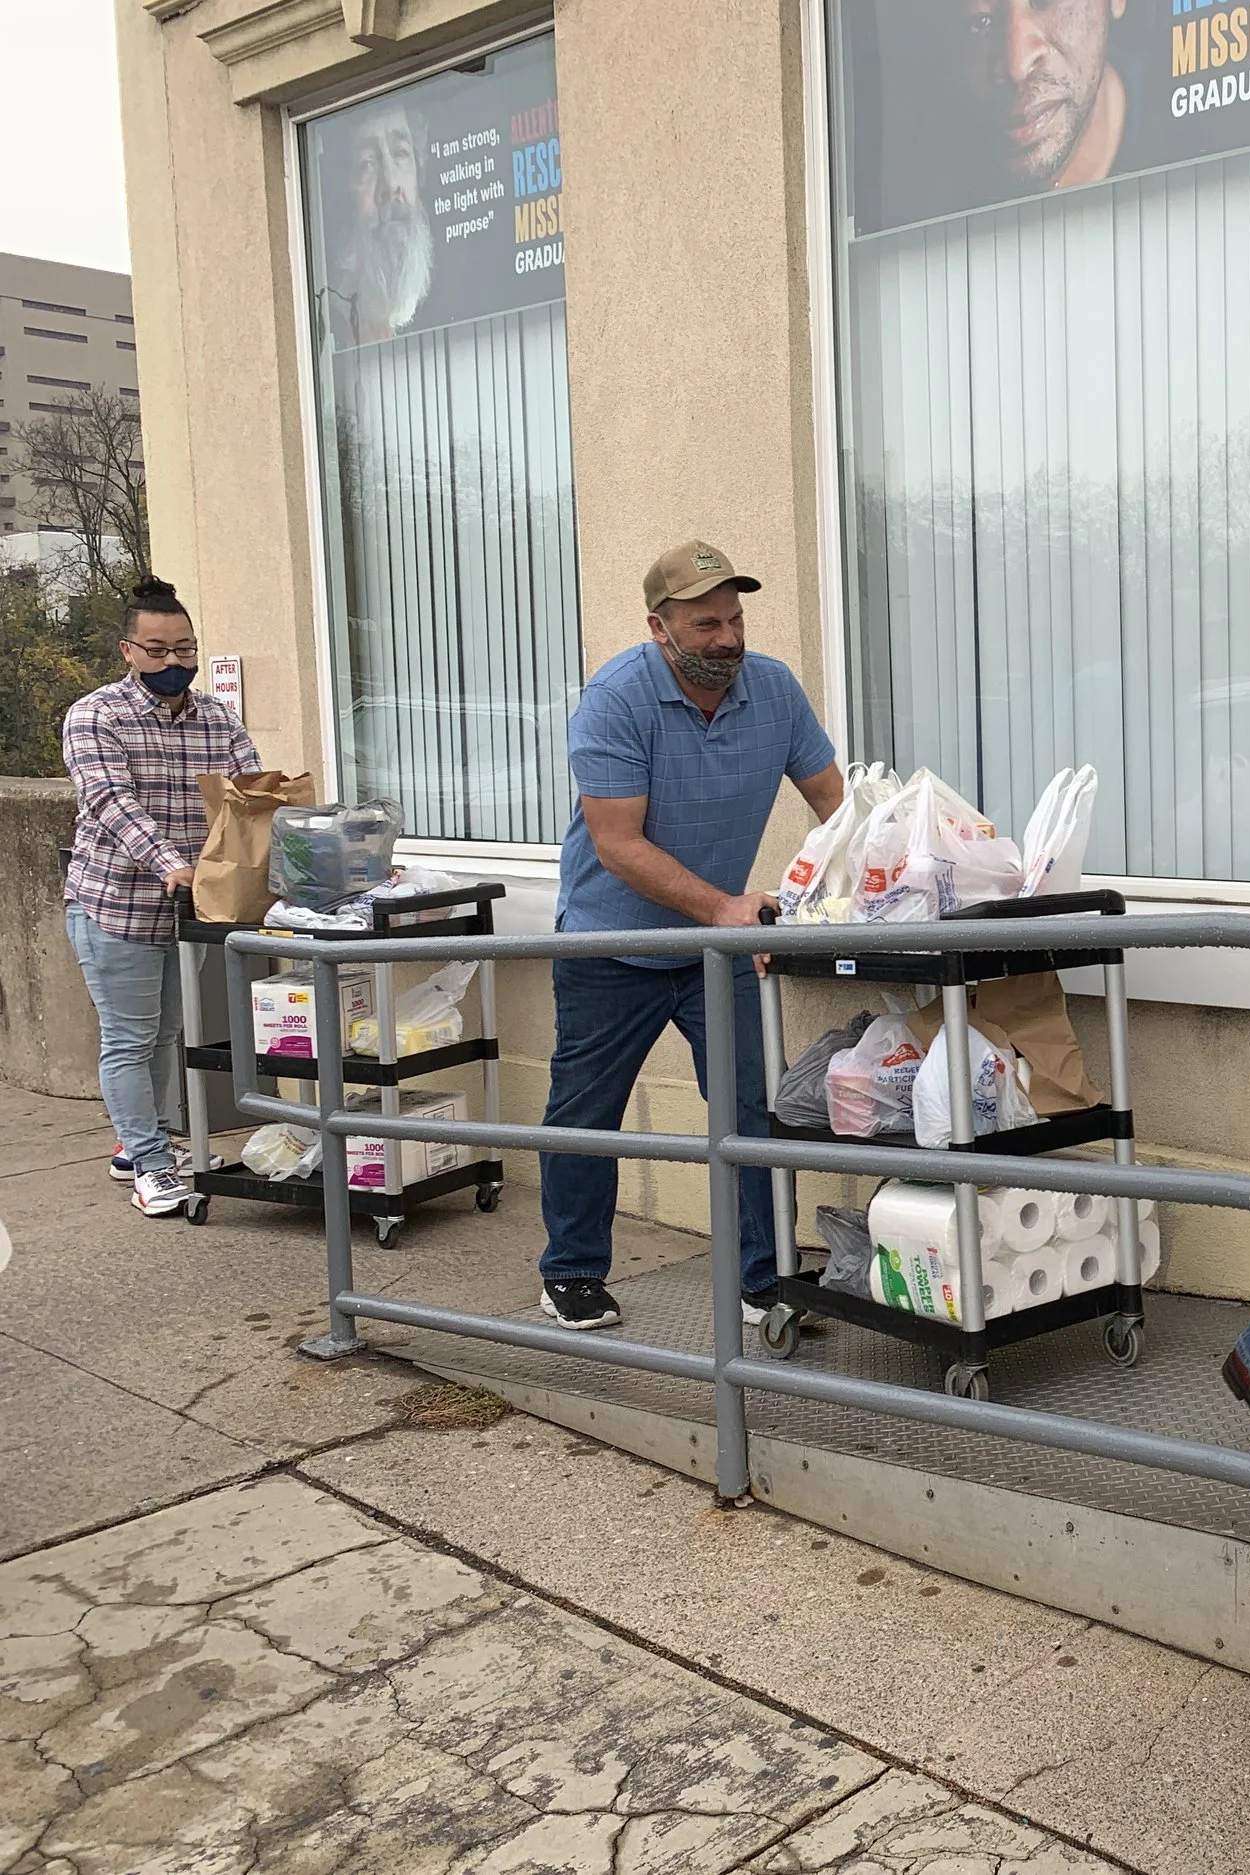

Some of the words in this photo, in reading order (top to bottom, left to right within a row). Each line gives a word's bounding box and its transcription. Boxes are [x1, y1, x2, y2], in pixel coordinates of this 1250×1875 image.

[511, 96, 559, 144] ALLENT
[443, 141, 460, 157] am
[462, 128, 500, 150] strong,
[440, 162, 481, 185] walking
[484, 156, 494, 172] in
[512, 138, 562, 198] RESC
[434, 194, 450, 215] the
[454, 189, 478, 212] light
[480, 181, 504, 201] with
[515, 193, 564, 243] MISSI
[515, 242, 565, 274] GRADU
[216, 664, 236, 674] AFTER
[216, 682, 237, 692] HOURS
[352, 999, 364, 1007] 1000
[282, 1015, 307, 1023] 1000
[894, 1066, 919, 1074] REDEE
[914, 1255, 929, 1312] TOWELS
[922, 1268, 935, 1313] PAPER
